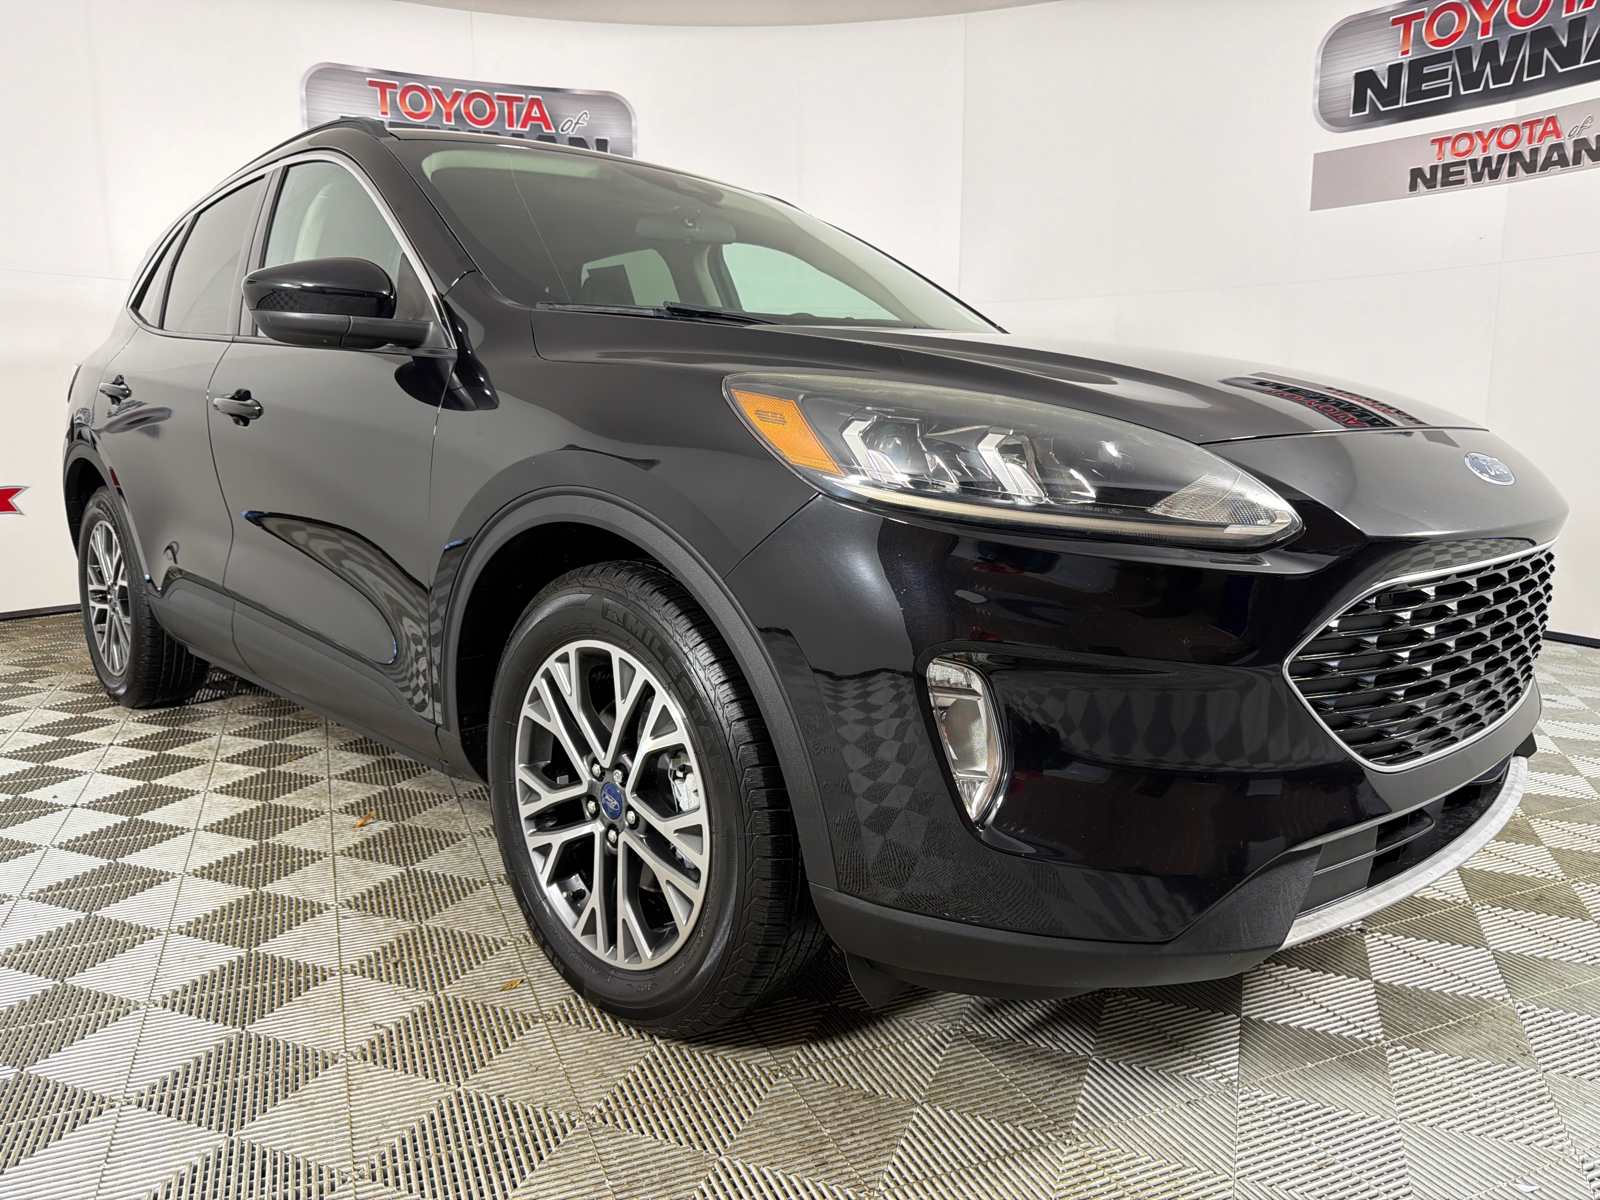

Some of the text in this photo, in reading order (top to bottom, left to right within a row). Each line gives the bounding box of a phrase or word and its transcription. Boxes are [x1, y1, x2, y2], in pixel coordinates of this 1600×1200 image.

[1390, 0, 1598, 57] TOYO
[366, 78, 555, 133] TOYOTA
[559, 110, 590, 135] of
[1408, 133, 1600, 194] NEWNAN
[1430, 114, 1594, 162] TOYOTA of
[621, 610, 734, 797] MILESTAR
